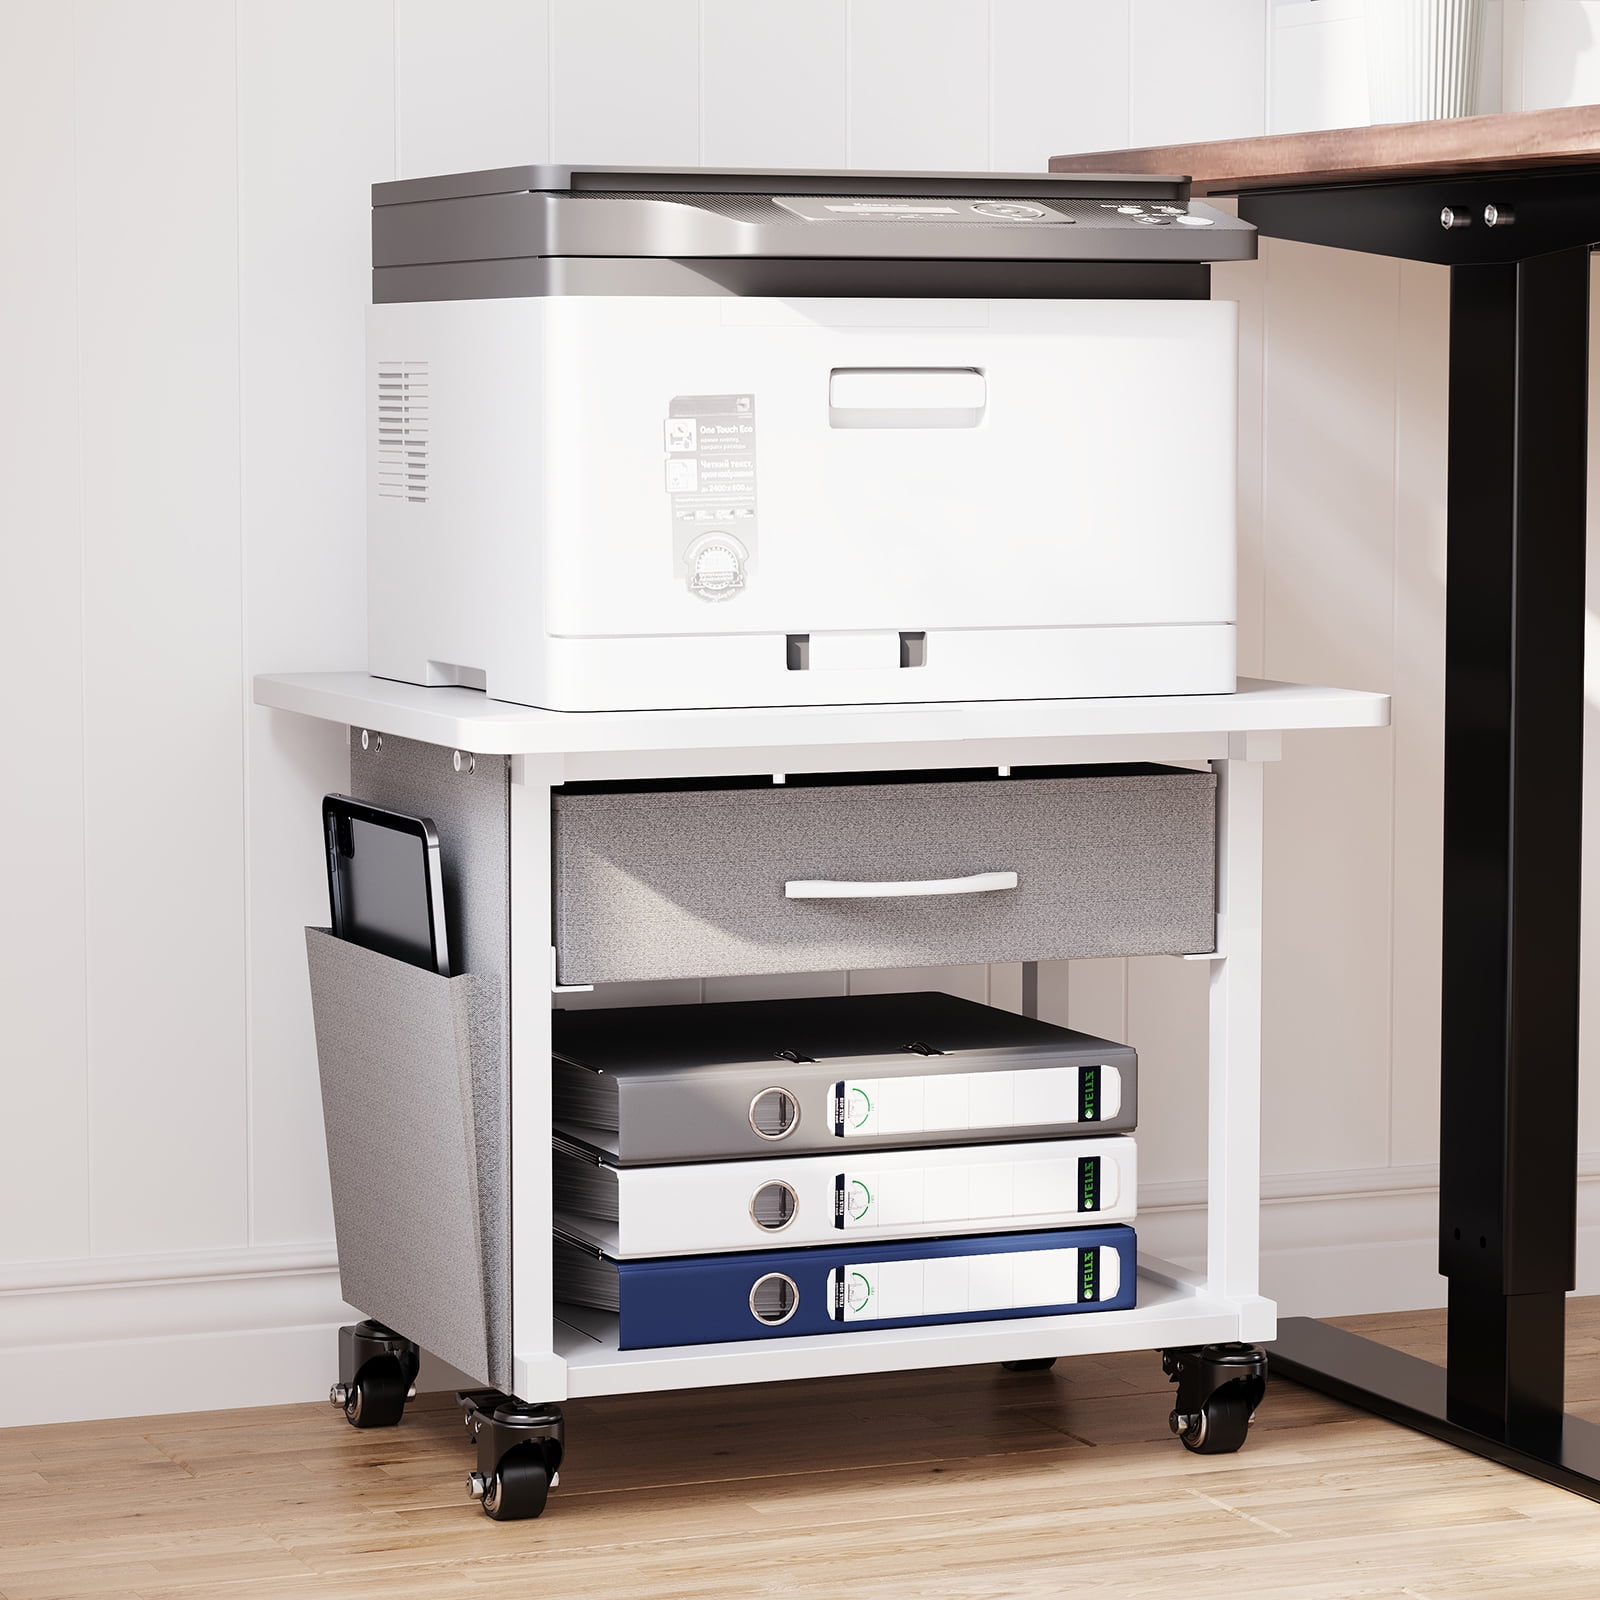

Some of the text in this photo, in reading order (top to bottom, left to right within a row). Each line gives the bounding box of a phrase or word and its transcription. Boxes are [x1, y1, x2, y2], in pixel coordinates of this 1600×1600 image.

[700, 424, 753, 434] One Touch Eco
